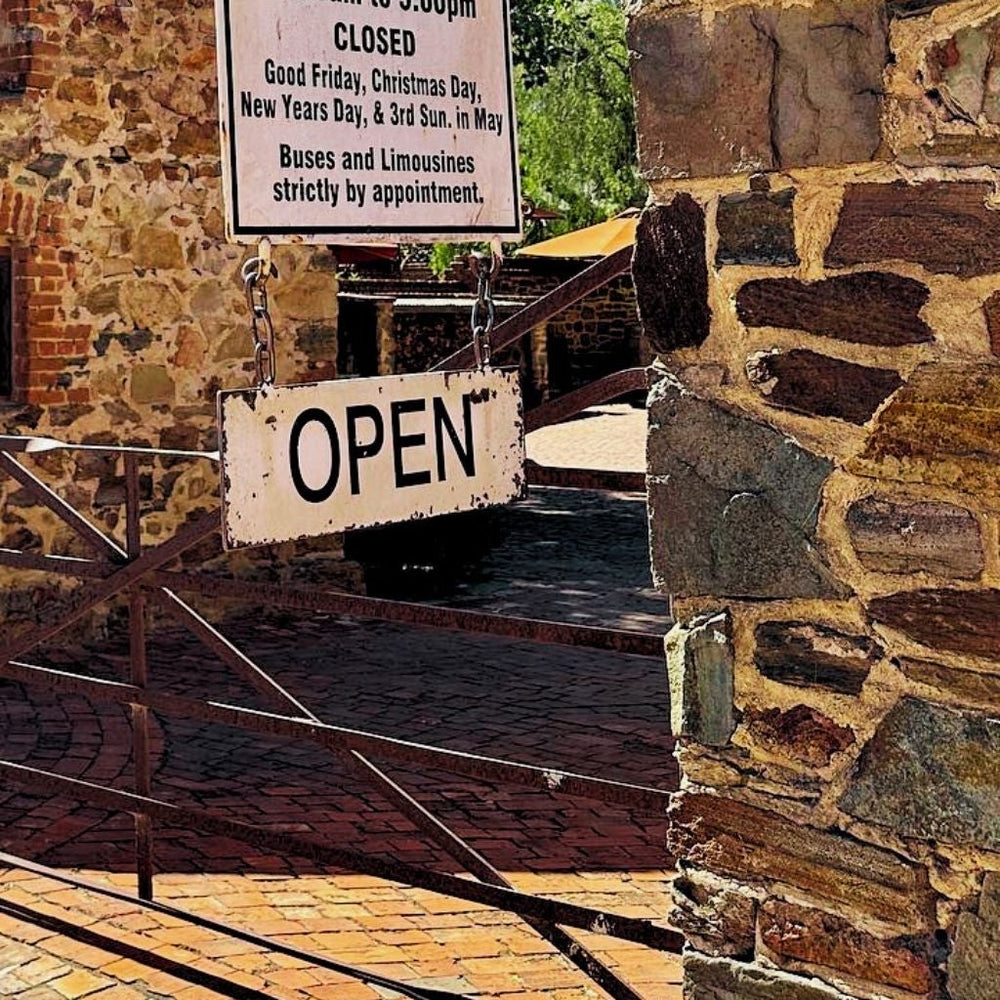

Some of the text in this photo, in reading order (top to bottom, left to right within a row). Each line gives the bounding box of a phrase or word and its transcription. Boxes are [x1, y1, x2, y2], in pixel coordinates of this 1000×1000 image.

[334, 22, 416, 57] CLOSED
[265, 59, 482, 102] Good Friday, Christmas Day,
[241, 91, 503, 135] New Years Day, & 3rd Sun. in May
[280, 144, 475, 173] Buses and Limousines
[273, 178, 484, 207] strictly by appointment.
[289, 393, 477, 503] OPEN
